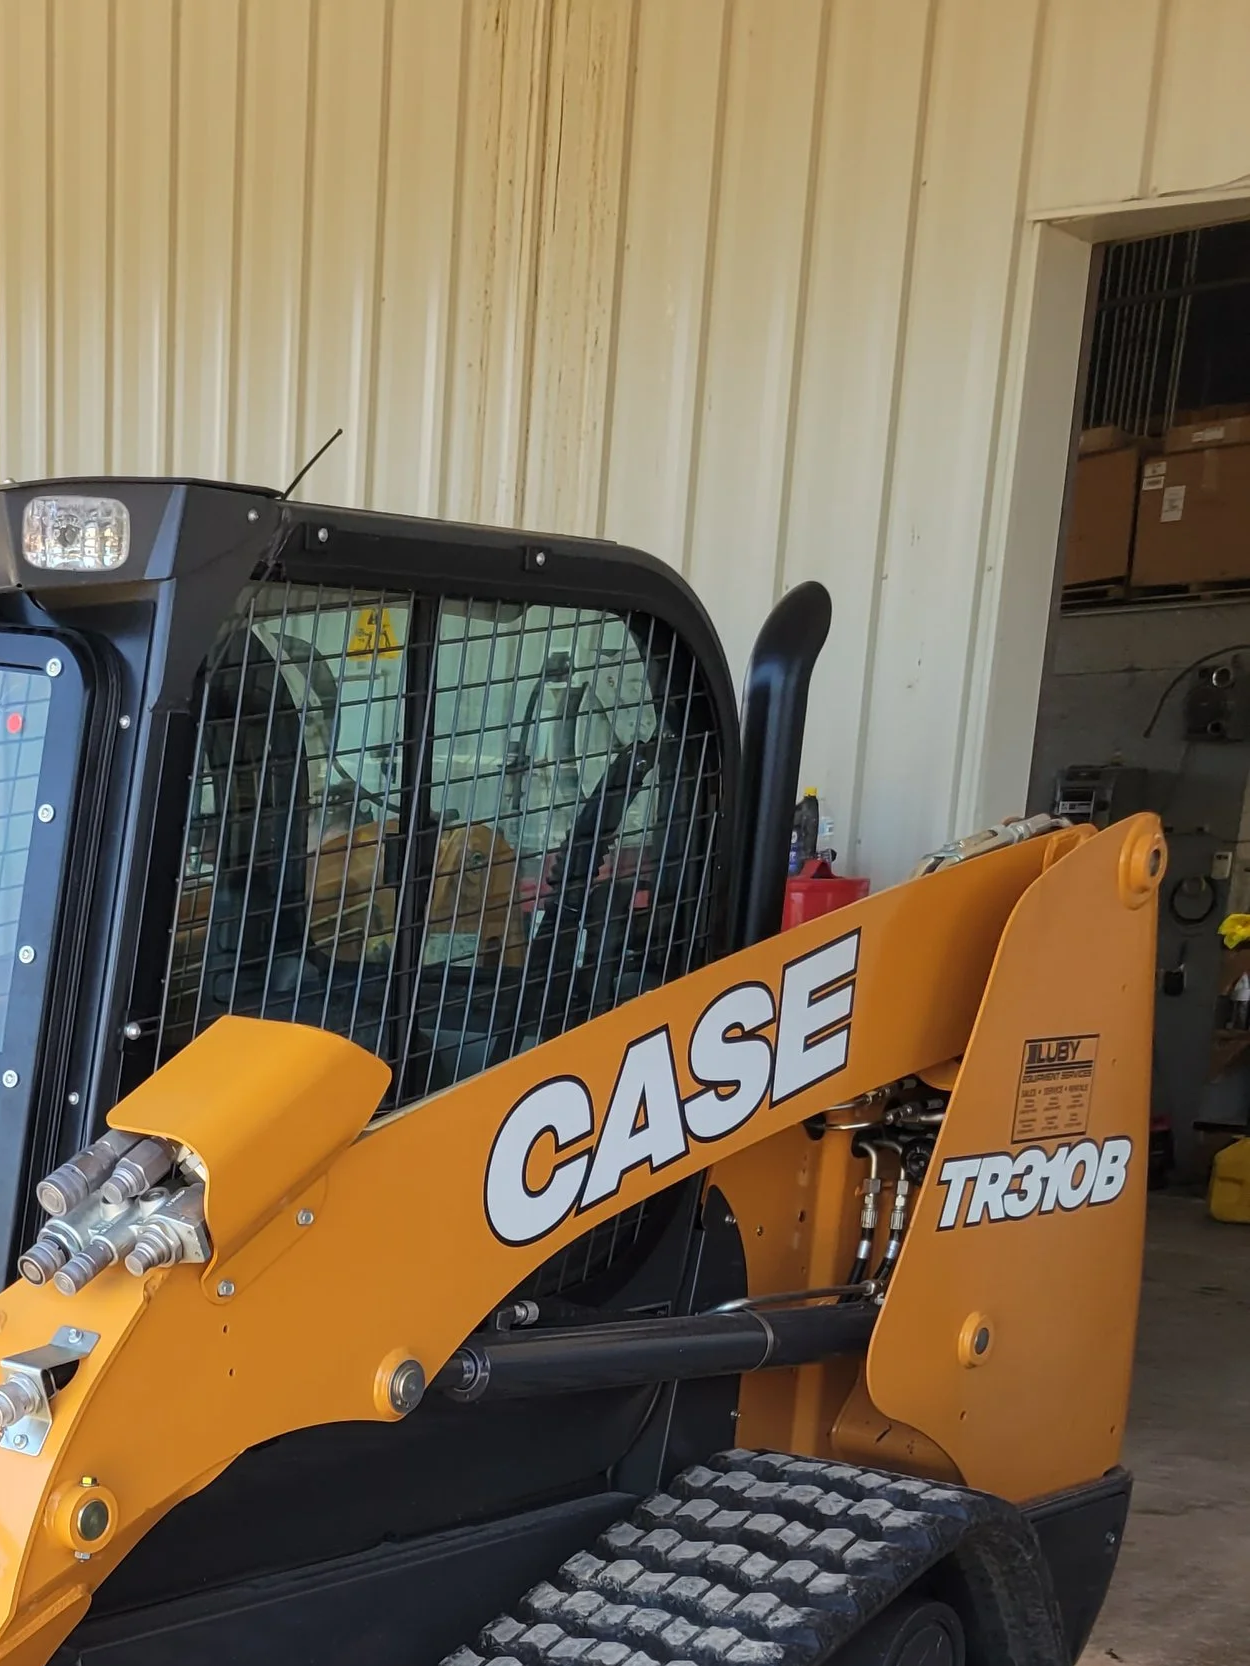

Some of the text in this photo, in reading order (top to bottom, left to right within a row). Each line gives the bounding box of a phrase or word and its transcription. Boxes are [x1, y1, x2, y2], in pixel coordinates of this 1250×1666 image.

[484, 927, 861, 1247] CASE
[1035, 1040, 1081, 1063] LUBY
[936, 1136, 1132, 1232] TR310B
